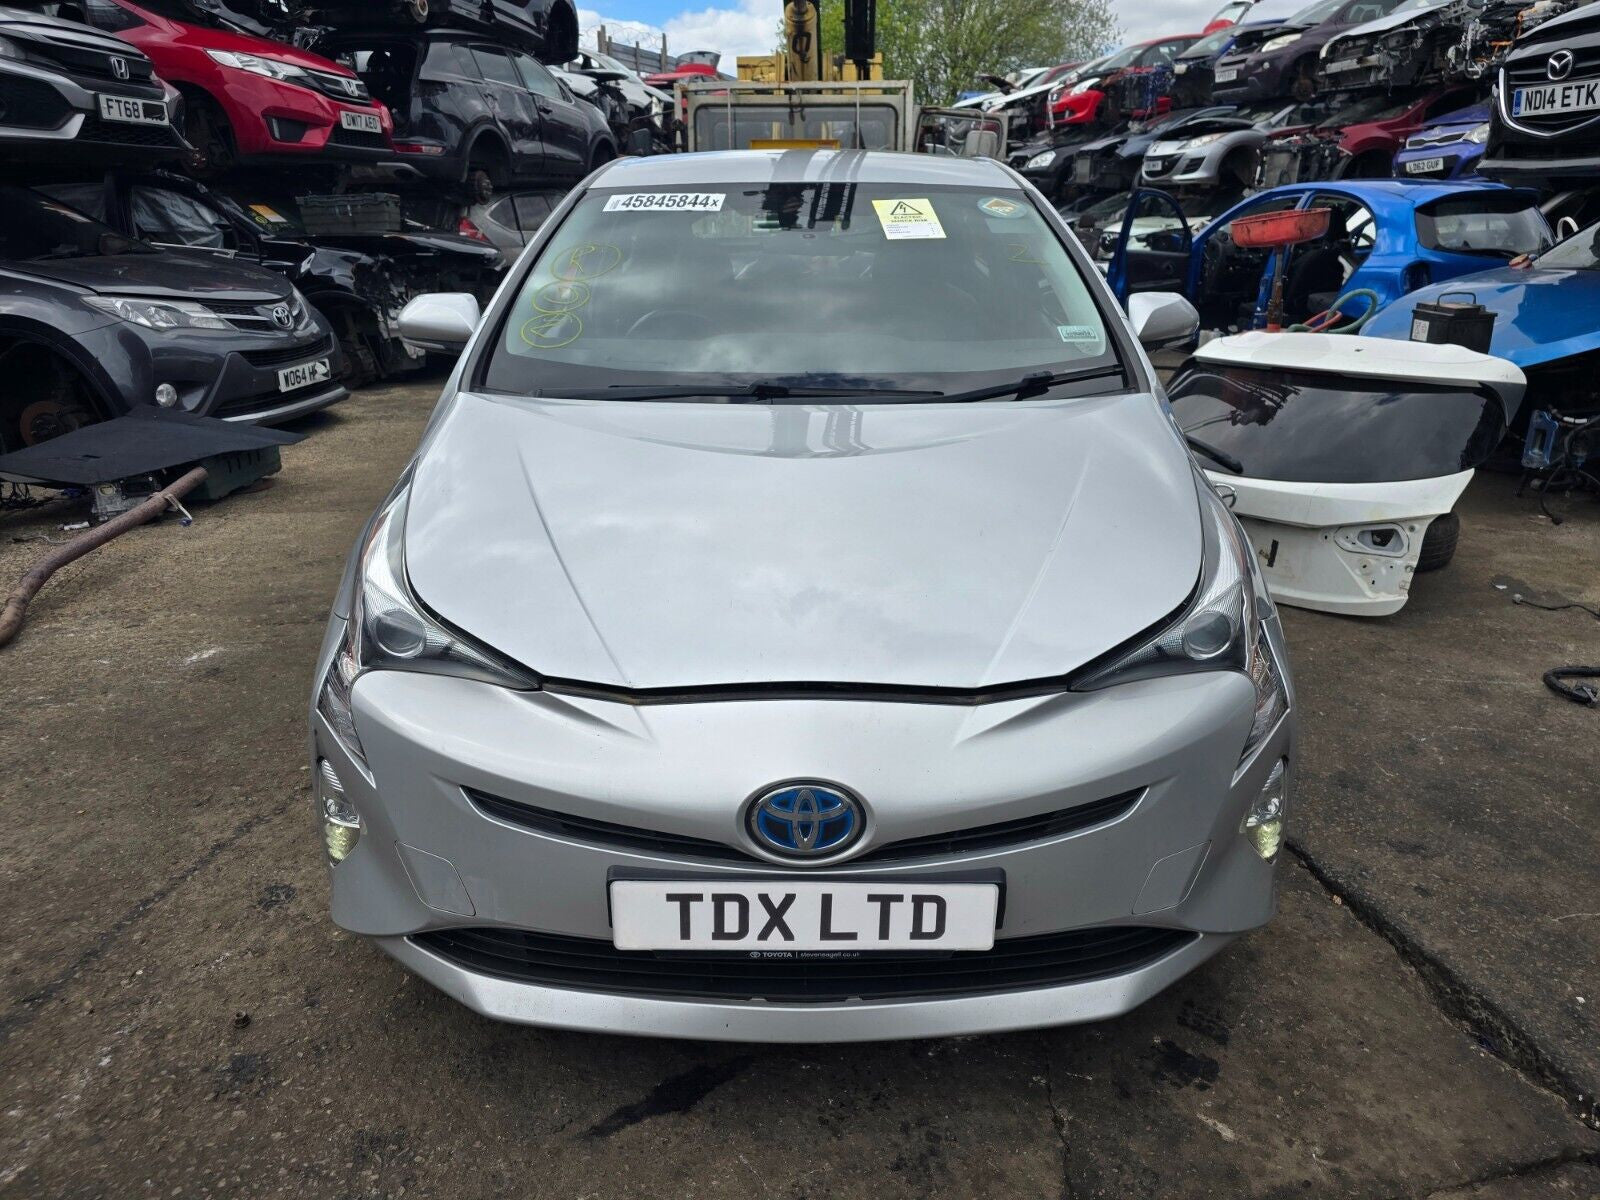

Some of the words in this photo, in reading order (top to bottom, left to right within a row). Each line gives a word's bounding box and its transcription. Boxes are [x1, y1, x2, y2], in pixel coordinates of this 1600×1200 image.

[106, 98, 141, 118] FT68
[1524, 88, 1556, 111] ND14
[1561, 83, 1599, 107] ETK
[666, 893, 797, 941] TDX
[820, 893, 948, 941] LTD
